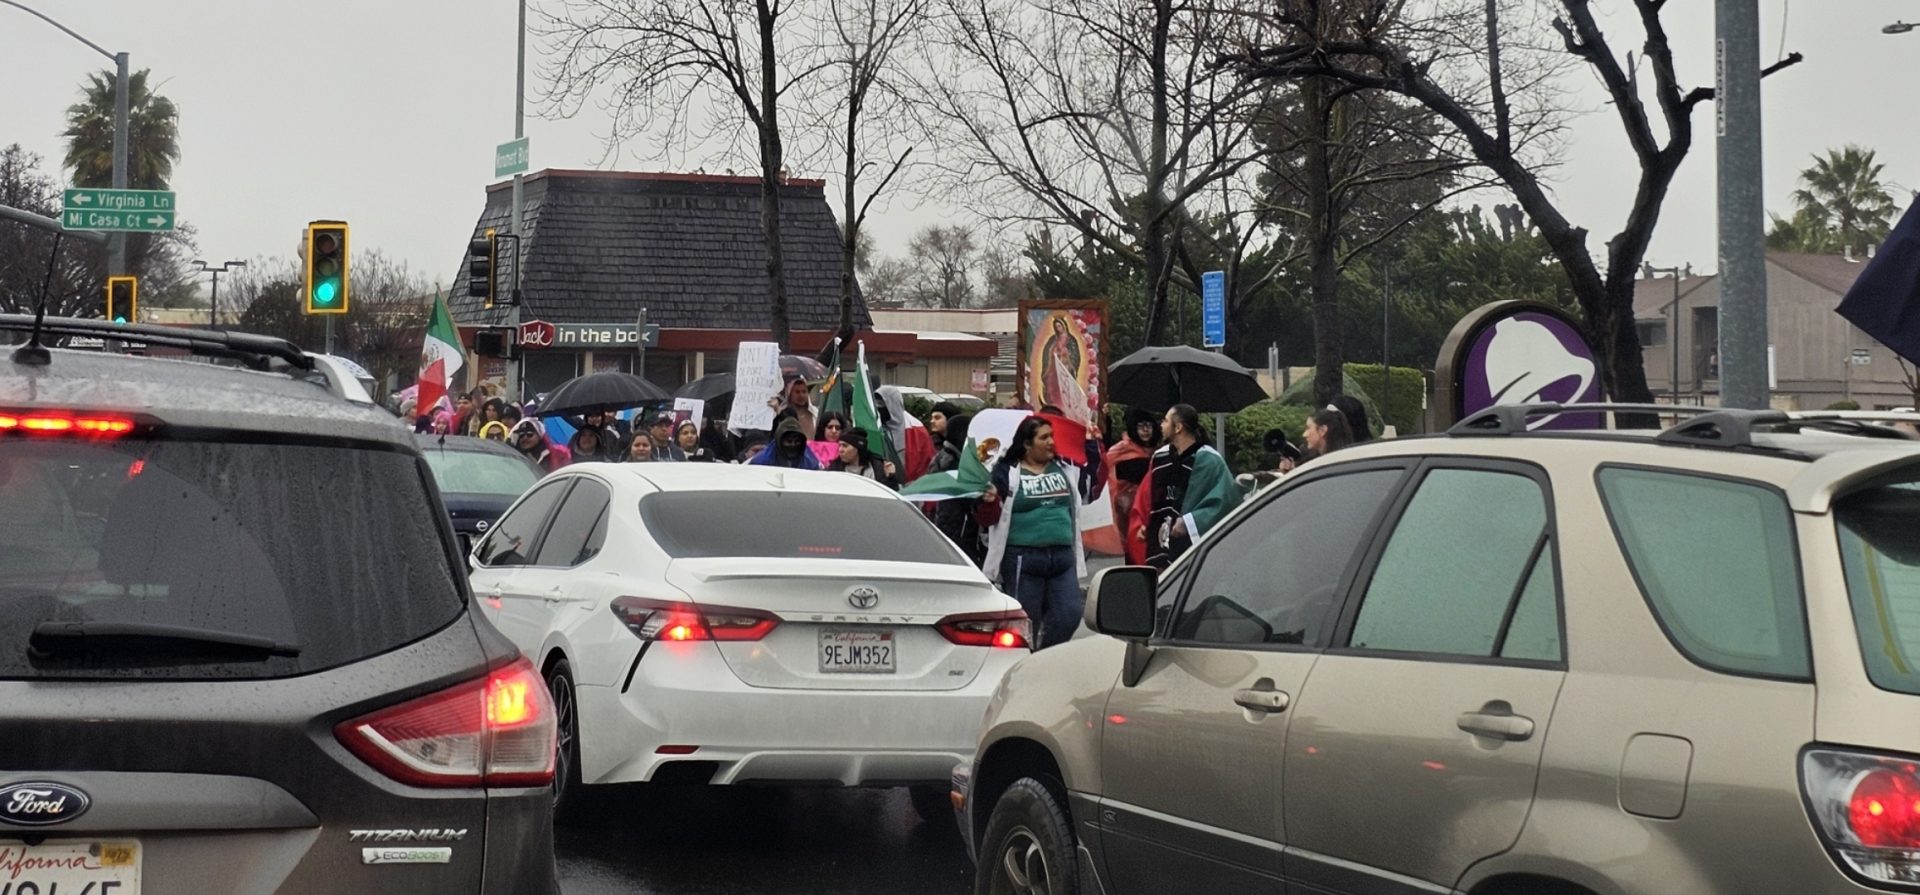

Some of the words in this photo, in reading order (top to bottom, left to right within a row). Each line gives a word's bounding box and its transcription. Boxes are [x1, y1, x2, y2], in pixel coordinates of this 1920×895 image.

[97, 193, 146, 208] Virginia
[153, 194, 169, 208] Ln
[69, 212, 83, 226] Mi
[89, 213, 120, 226] Casa
[126, 214, 142, 228] Ct
[520, 324, 553, 346] Jack
[559, 327, 576, 343] in
[580, 328, 612, 343] the
[615, 328, 651, 343] box
[1022, 473, 1067, 496] MEXICO
[833, 632, 879, 644] California
[825, 645, 890, 665] 9EJM352
[7, 788, 66, 814] Ford
[349, 828, 468, 841] TITANIUM
